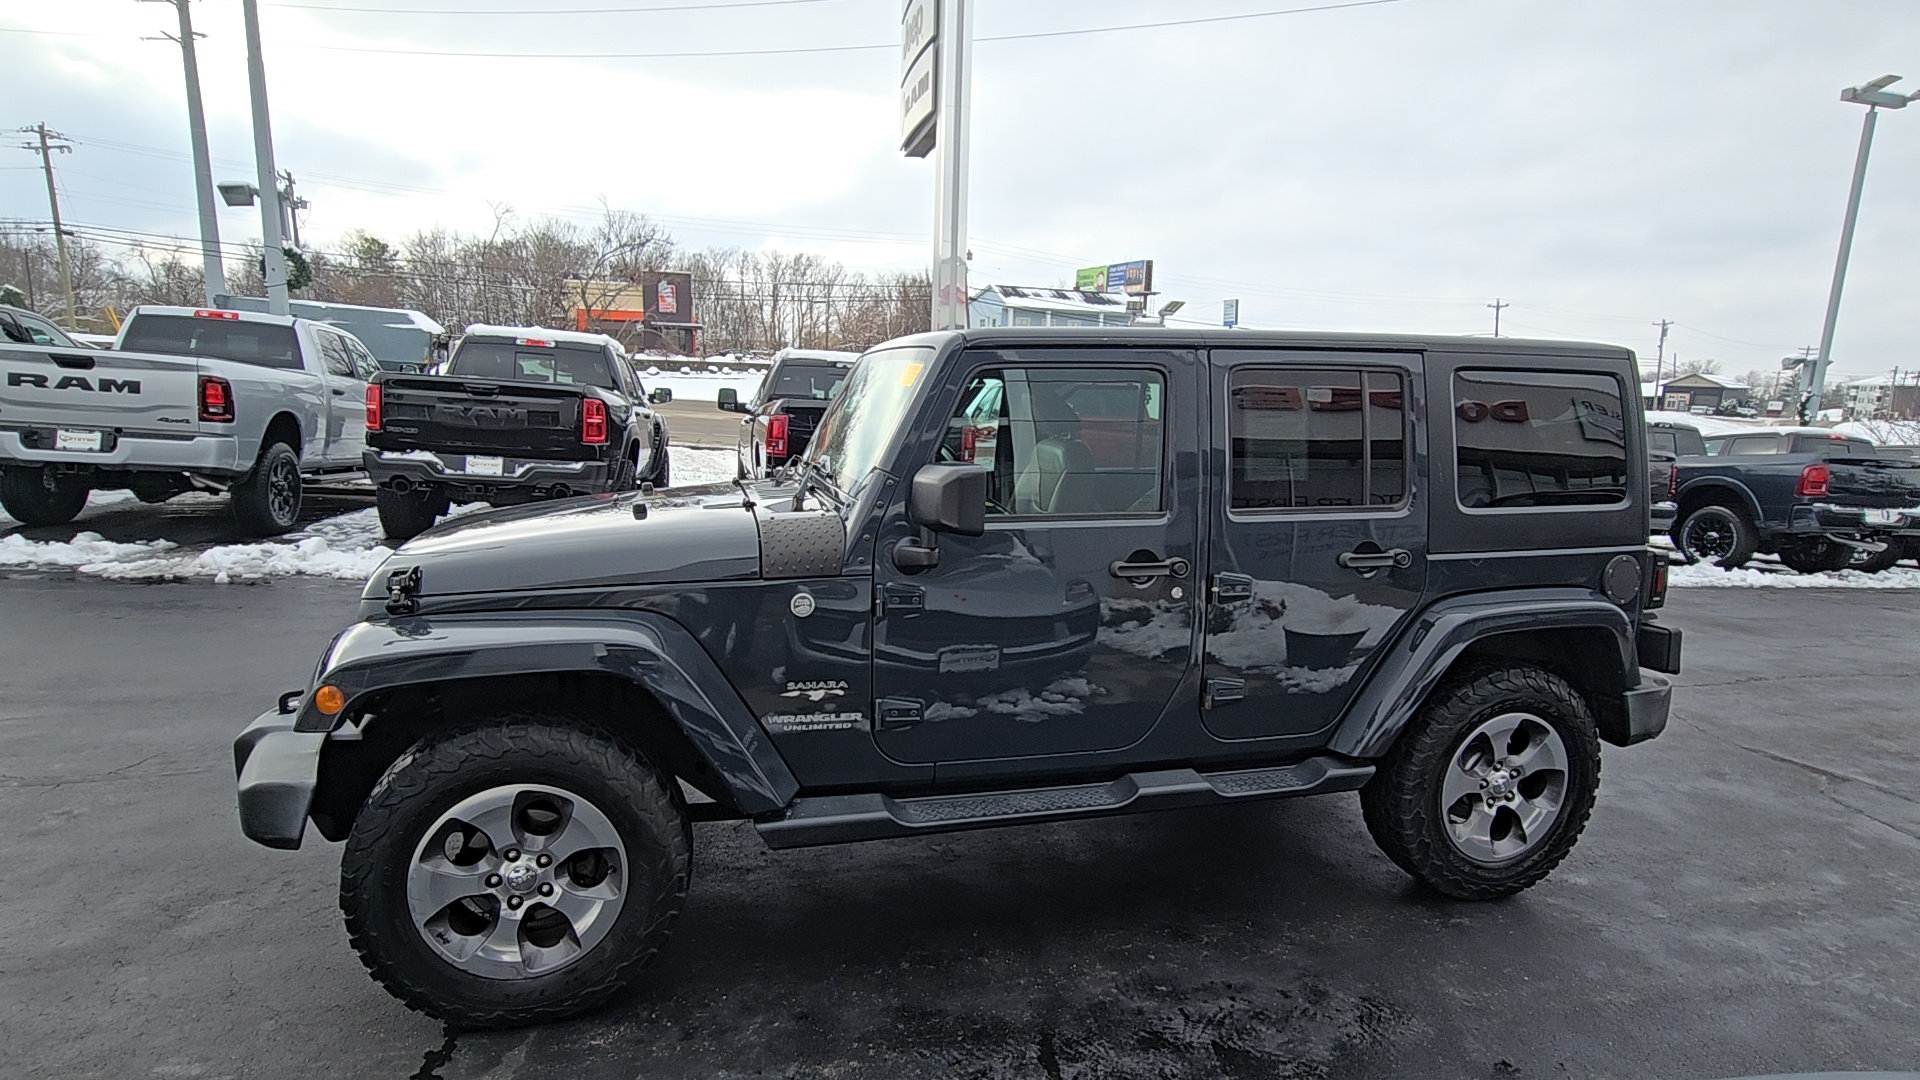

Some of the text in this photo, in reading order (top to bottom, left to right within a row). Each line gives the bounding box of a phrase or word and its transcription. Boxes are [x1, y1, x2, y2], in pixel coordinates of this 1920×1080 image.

[7, 372, 142, 395] RAM
[434, 404, 528, 421] RAM
[156, 417, 192, 425] 4x4
[787, 681, 848, 690] SAHARA
[768, 712, 863, 724] WRANGLER
[783, 723, 852, 731] UNLIMITED
